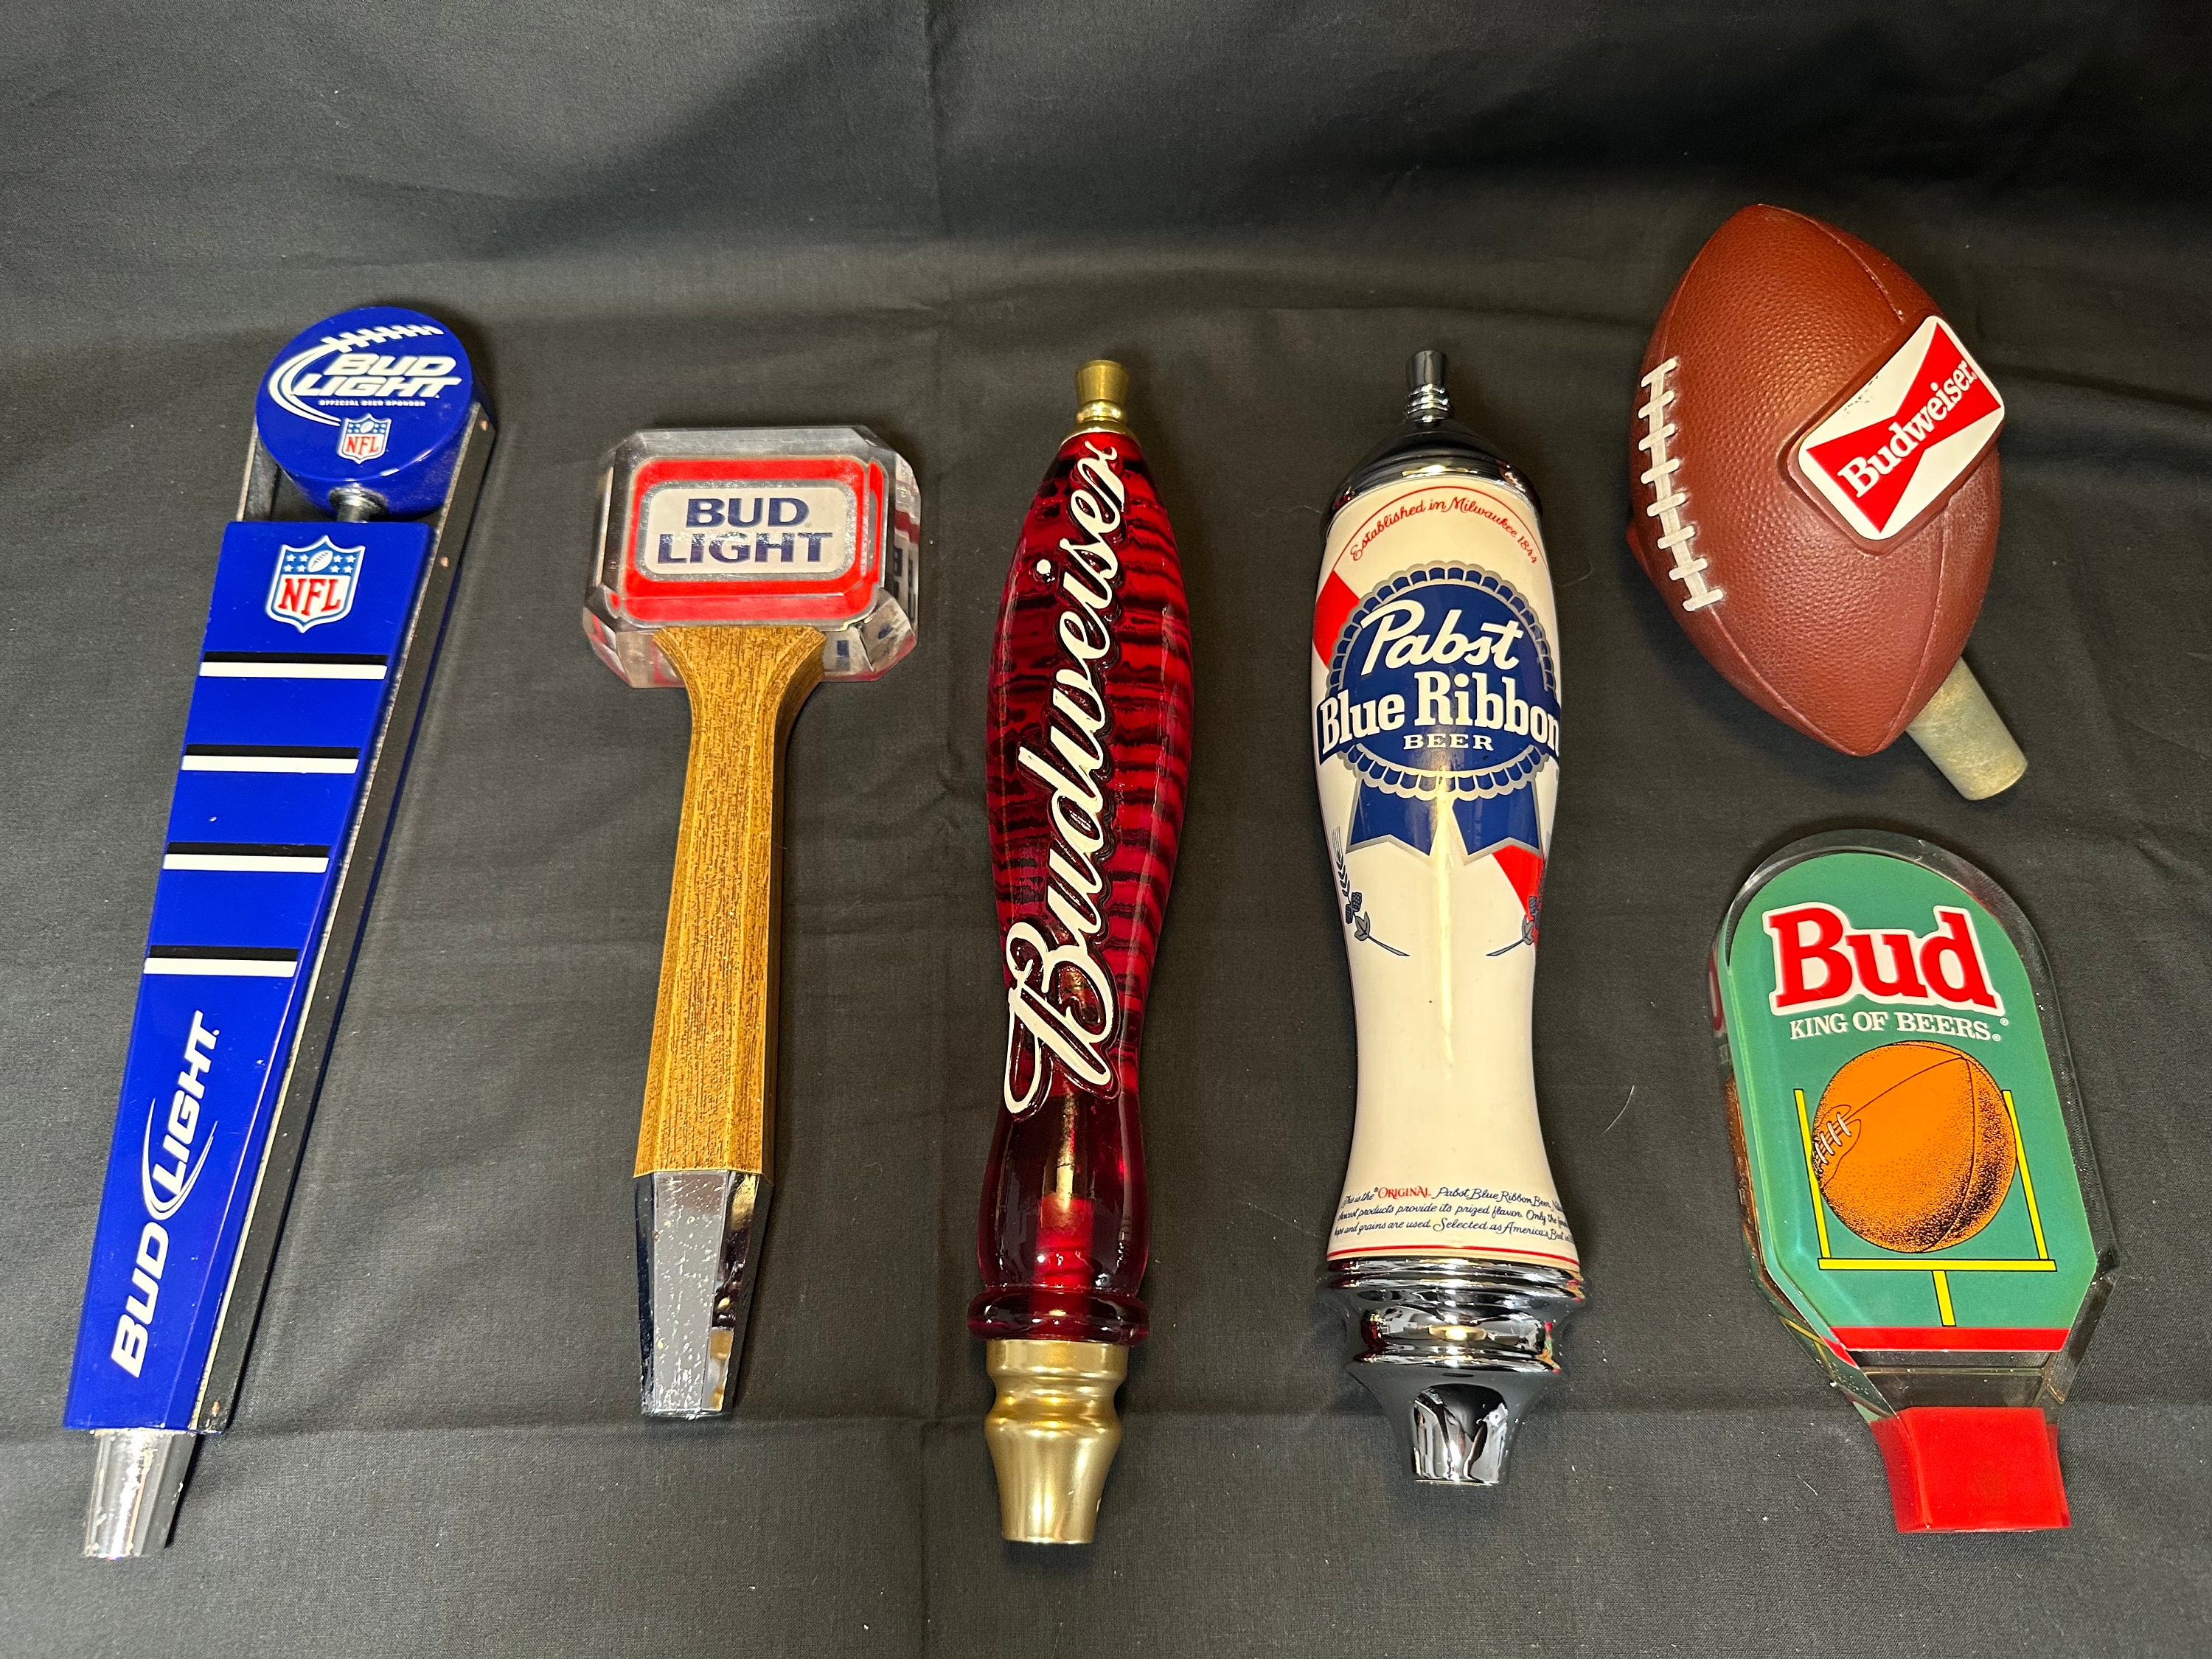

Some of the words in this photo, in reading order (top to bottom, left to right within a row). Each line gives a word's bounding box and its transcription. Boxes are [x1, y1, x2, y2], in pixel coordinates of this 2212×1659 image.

[324, 353, 457, 377] BUD
[293, 377, 462, 399] LIGHT
[1837, 360, 1978, 498] Budweiser
[345, 436, 379, 456] NFL
[686, 497, 810, 528] BUD
[1350, 500, 1426, 562] Established
[1427, 499, 1445, 512] in
[1442, 496, 1517, 538] Milwaukee
[657, 532, 833, 565] LIGHT
[278, 578, 341, 616] NFL
[1360, 599, 1523, 676] Pabst
[1319, 689, 1405, 754] Blue
[1414, 669, 1559, 759] Ribbon
[1403, 733, 1494, 751] BEER
[1004, 439, 1119, 1116] Budweiser
[1762, 902, 2005, 1017] Bud
[1790, 1012, 1848, 1040] KING
[1852, 1011, 1888, 1032] OF
[1893, 1012, 1992, 1041] BEERS
[152, 1009, 219, 1197] LIGHT
[1377, 1186, 1432, 1200] ORIGINAL
[1431, 1186, 1470, 1200] Pabst
[1467, 1189, 1499, 1200] Blue
[1496, 1191, 1532, 1204] Ribbon
[1343, 1222, 1358, 1234] and
[1357, 1223, 1387, 1235] grains
[1433, 1217, 1489, 1232] Selected
[1488, 1223, 1502, 1231] as
[1495, 1221, 1549, 1237] America's
[1547, 1228, 1565, 1241] Best
[1357, 1203, 1394, 1220] products
[1394, 1203, 1439, 1216] provide
[1439, 1203, 1453, 1213] its
[1454, 1205, 1490, 1217] prized
[1526, 1209, 1546, 1225] Only
[1547, 1214, 1557, 1224] the
[110, 1221, 170, 1379] BUD
